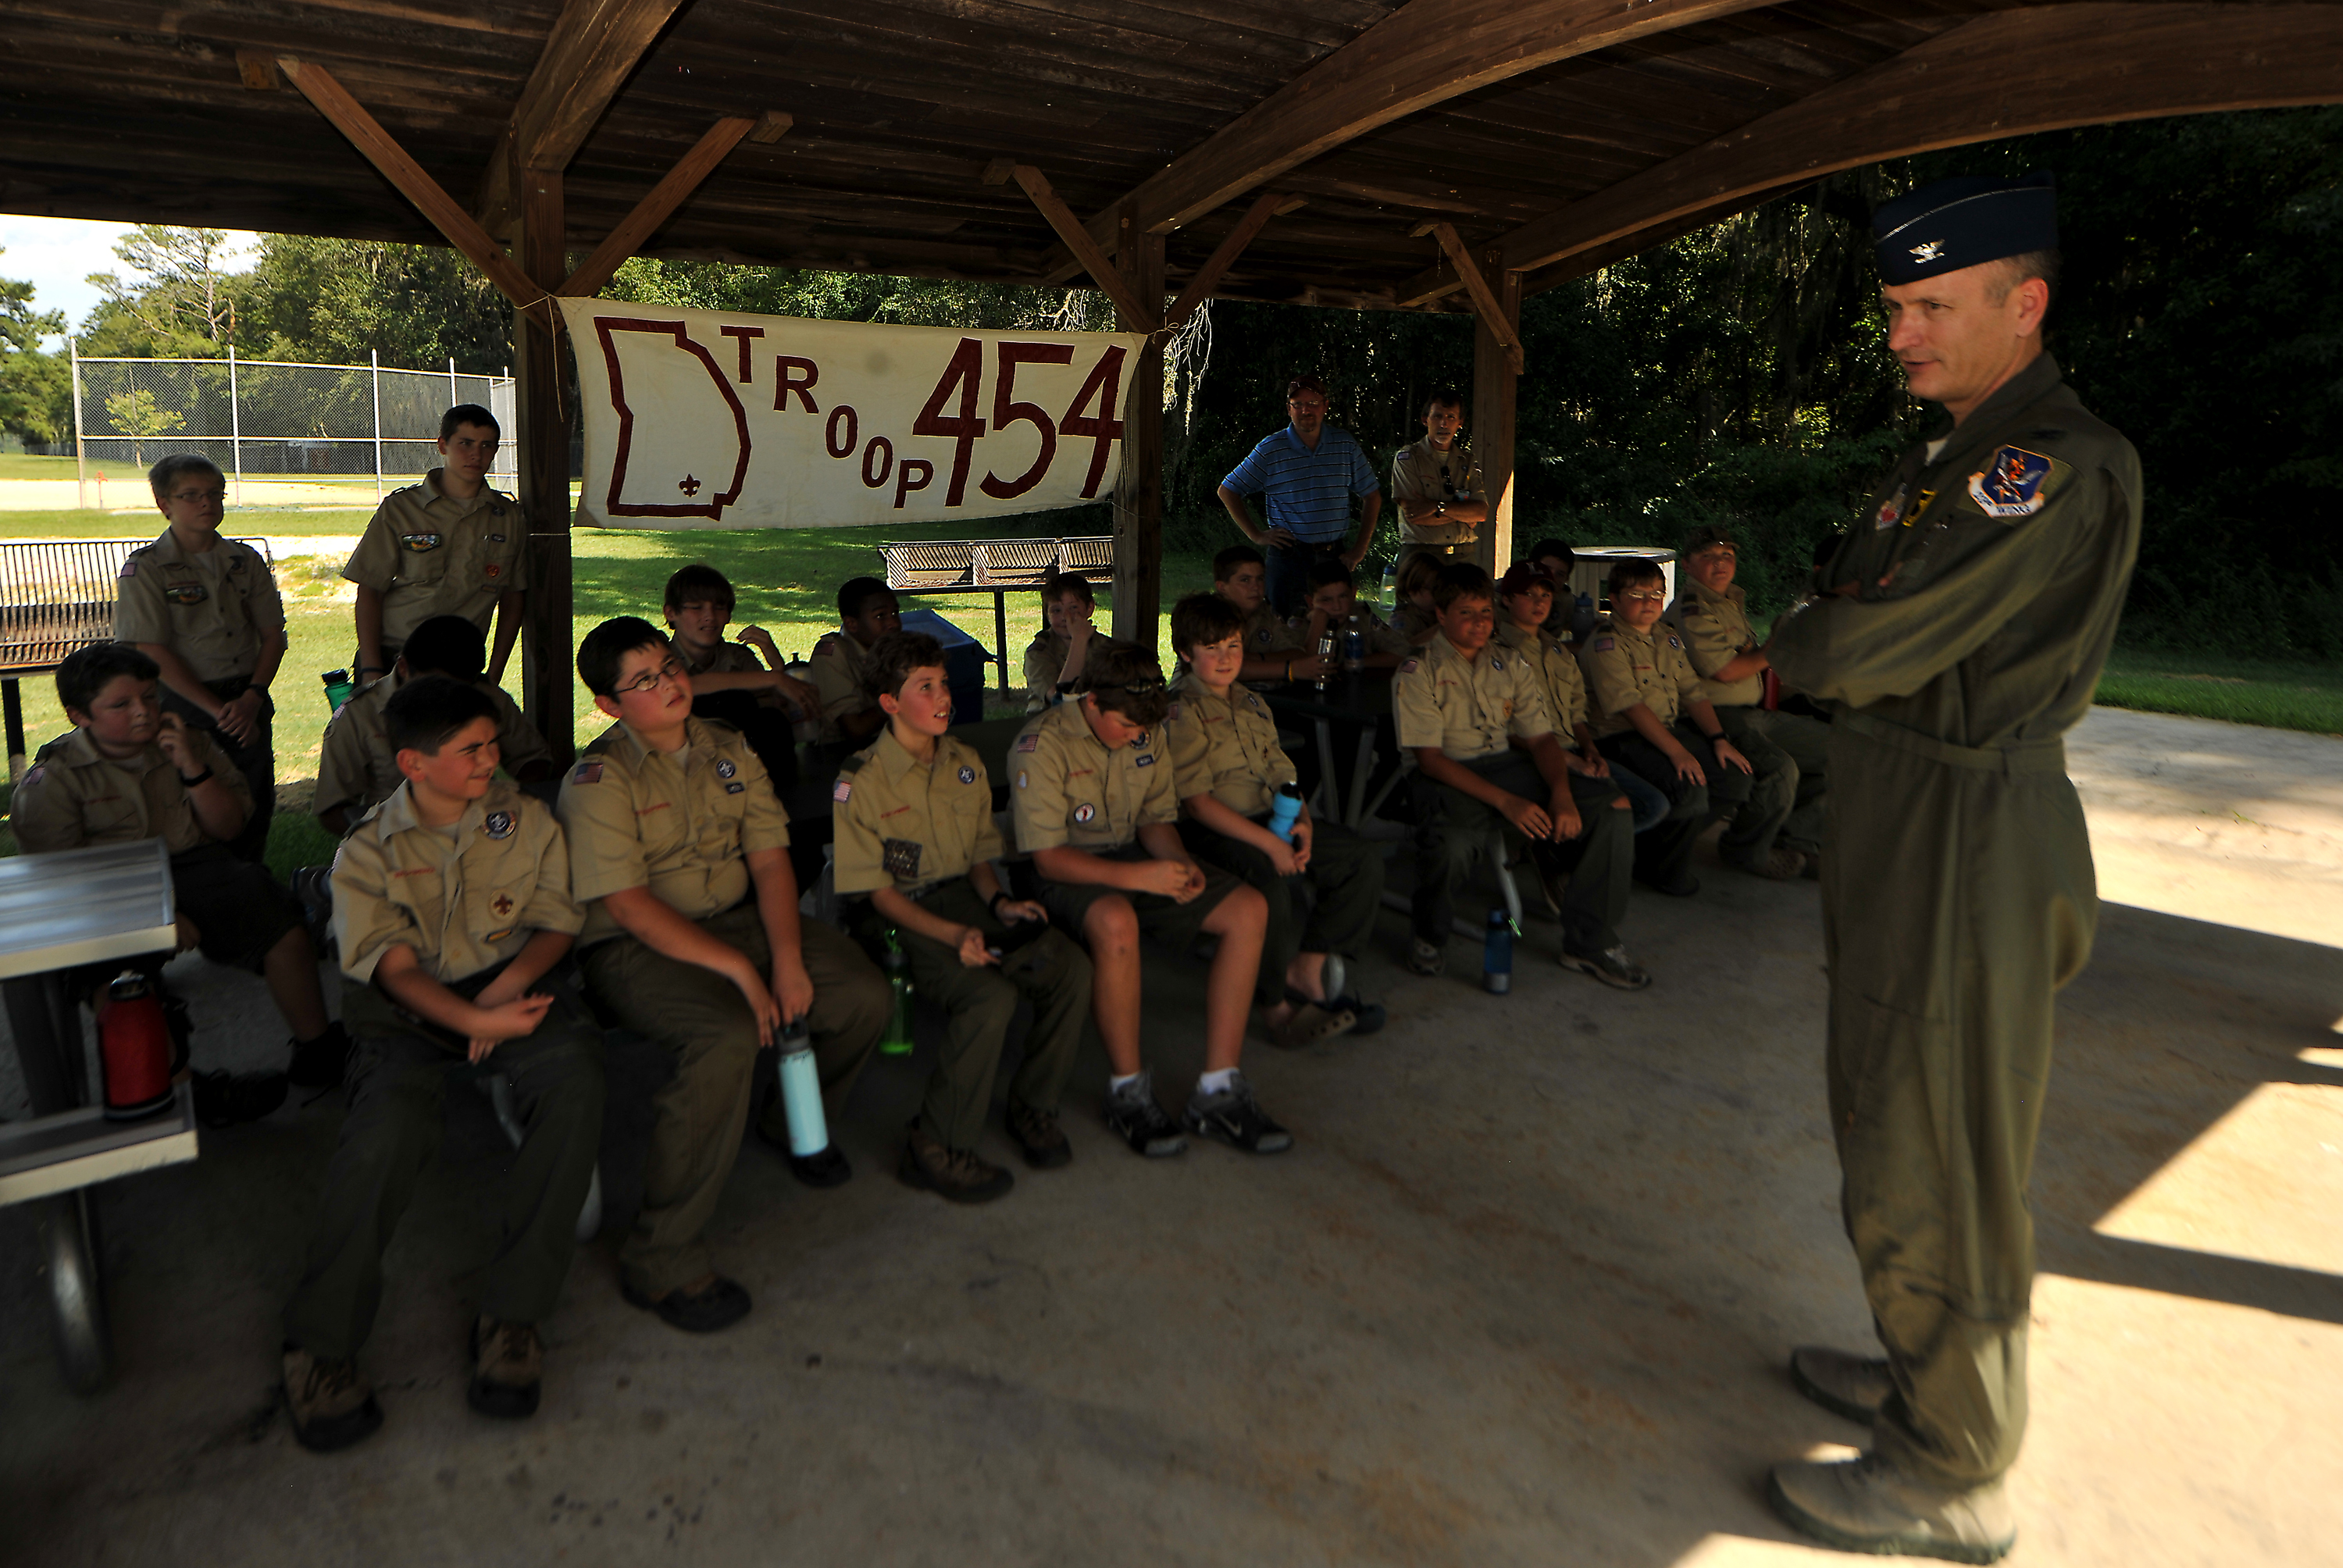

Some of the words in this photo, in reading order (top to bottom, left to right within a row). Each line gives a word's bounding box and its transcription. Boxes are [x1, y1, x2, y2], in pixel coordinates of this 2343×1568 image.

[720, 326, 934, 508] TROOP
[912, 337, 1127, 507] 454
[1525, 561, 1545, 576] L
